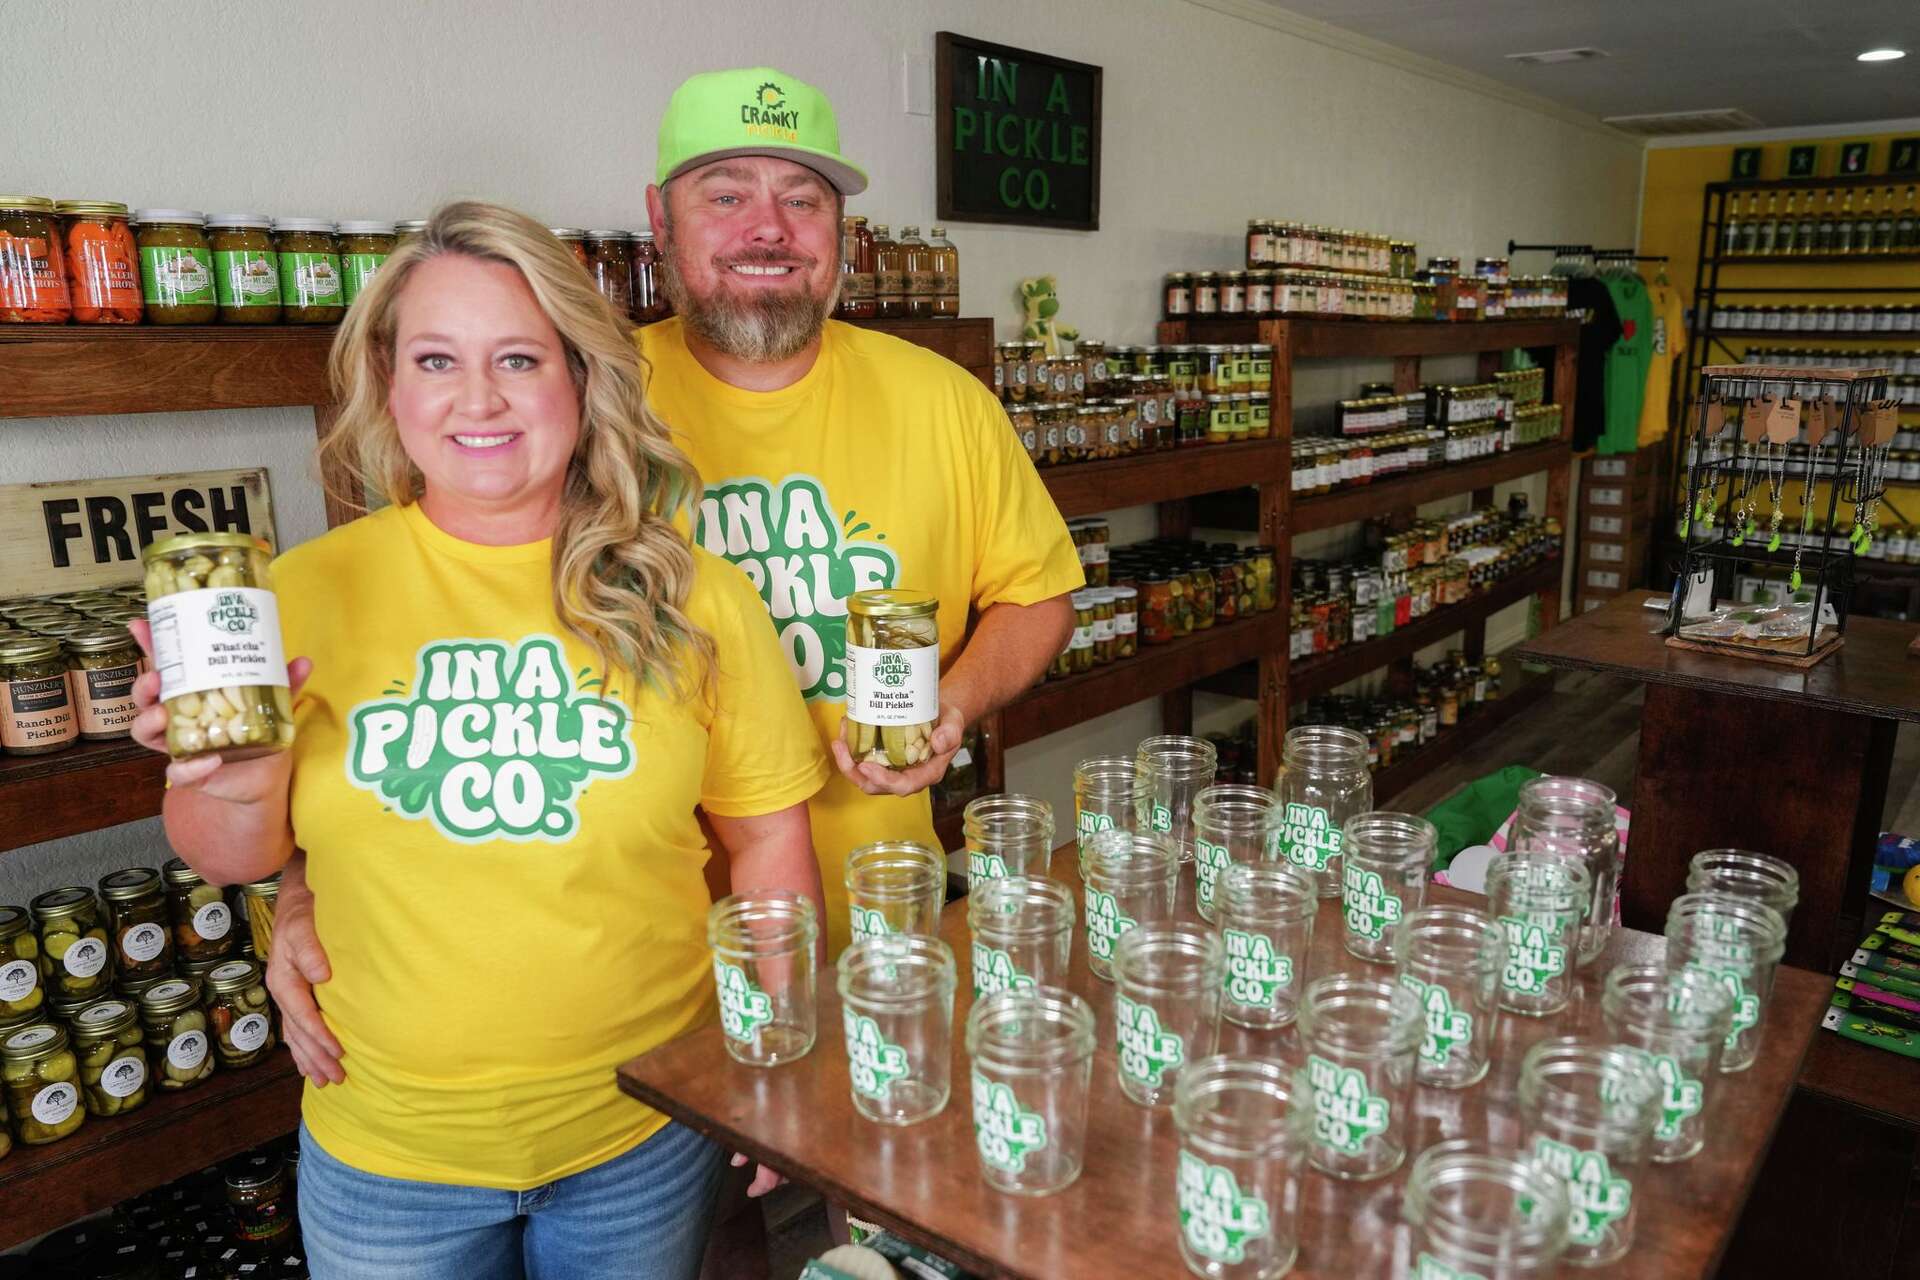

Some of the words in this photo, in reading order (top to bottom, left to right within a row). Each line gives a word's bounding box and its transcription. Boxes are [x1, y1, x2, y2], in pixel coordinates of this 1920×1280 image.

[977, 56, 1019, 105] IN
[1046, 73, 1070, 114] A
[741, 105, 799, 129] CRANKY
[954, 107, 1089, 166] PICKLE
[1000, 167, 1056, 209] CO.
[43, 486, 251, 568] FRESH
[700, 490, 770, 557] IN
[784, 488, 829, 549] A
[427, 649, 500, 701] IN
[515, 647, 562, 699] A
[780, 622, 844, 691] O.
[16, 718, 53, 729] Ranch
[27, 727, 67, 740] Pickles
[92, 703, 127, 716] Ranch
[360, 702, 623, 774] PICKLE
[440, 759, 565, 830] CO.
